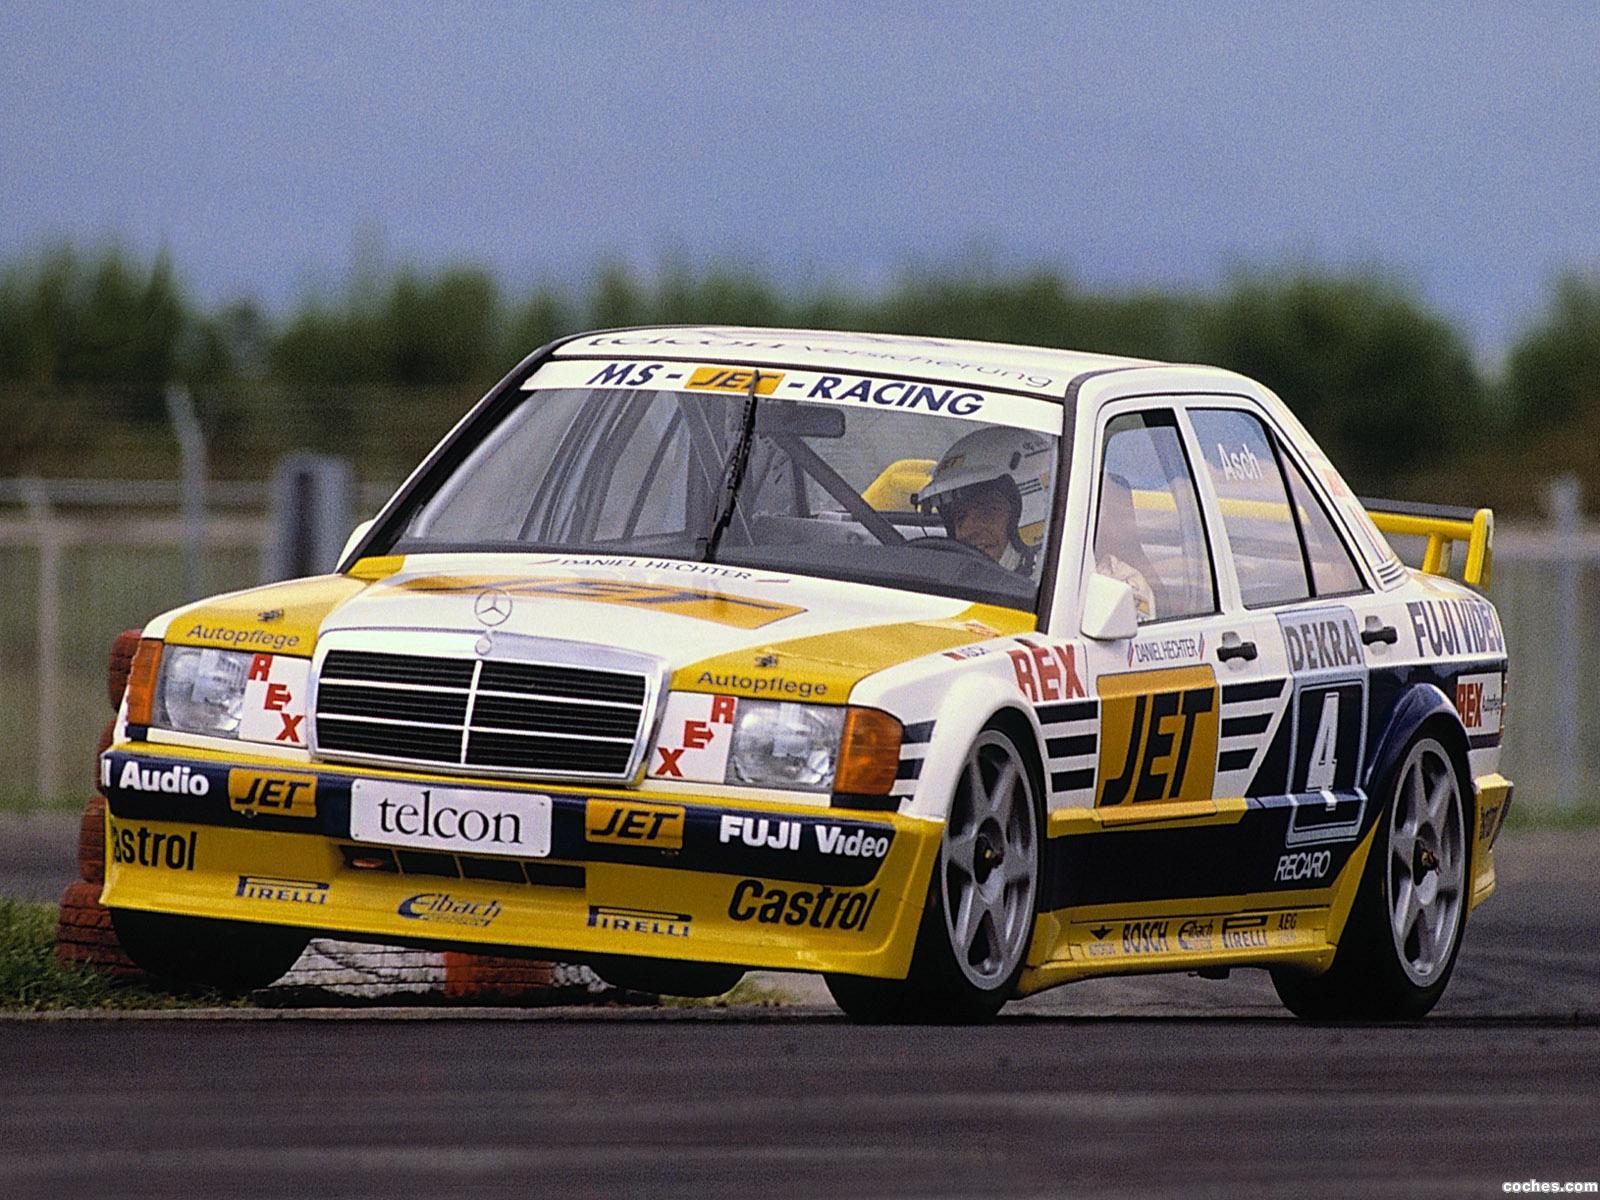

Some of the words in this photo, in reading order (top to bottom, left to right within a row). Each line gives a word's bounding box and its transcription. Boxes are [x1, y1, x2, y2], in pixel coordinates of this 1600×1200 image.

[1217, 442, 1263, 481] Asch
[561, 559, 636, 569] DANIEL
[643, 562, 752, 580] HECHTER
[186, 624, 300, 648] Autopflege
[1286, 620, 1361, 672] DEKRA
[1406, 600, 1460, 658] FUJI
[1134, 645, 1164, 663] DANIEL
[1163, 638, 1199, 662] HECHTER
[699, 671, 828, 696] Autopflege
[1007, 643, 1086, 702] REX
[1456, 682, 1484, 728] REX
[1100, 687, 1215, 807] JET
[1304, 691, 1341, 812] 4
[119, 760, 210, 796] Audio
[234, 778, 310, 809] JET
[377, 790, 523, 846] telcon
[591, 807, 679, 840] JET
[719, 815, 801, 851] FUJI
[814, 824, 889, 859] Video
[112, 826, 198, 871] astrol
[1274, 850, 1331, 882] RECARO
[236, 875, 329, 905] PIRELLI
[728, 879, 881, 932] Castrol
[397, 893, 502, 927] Eibach
[588, 905, 691, 938] PIRELLI
[1122, 920, 1169, 953] BOSCH
[1222, 915, 1269, 950] PIRELLI
